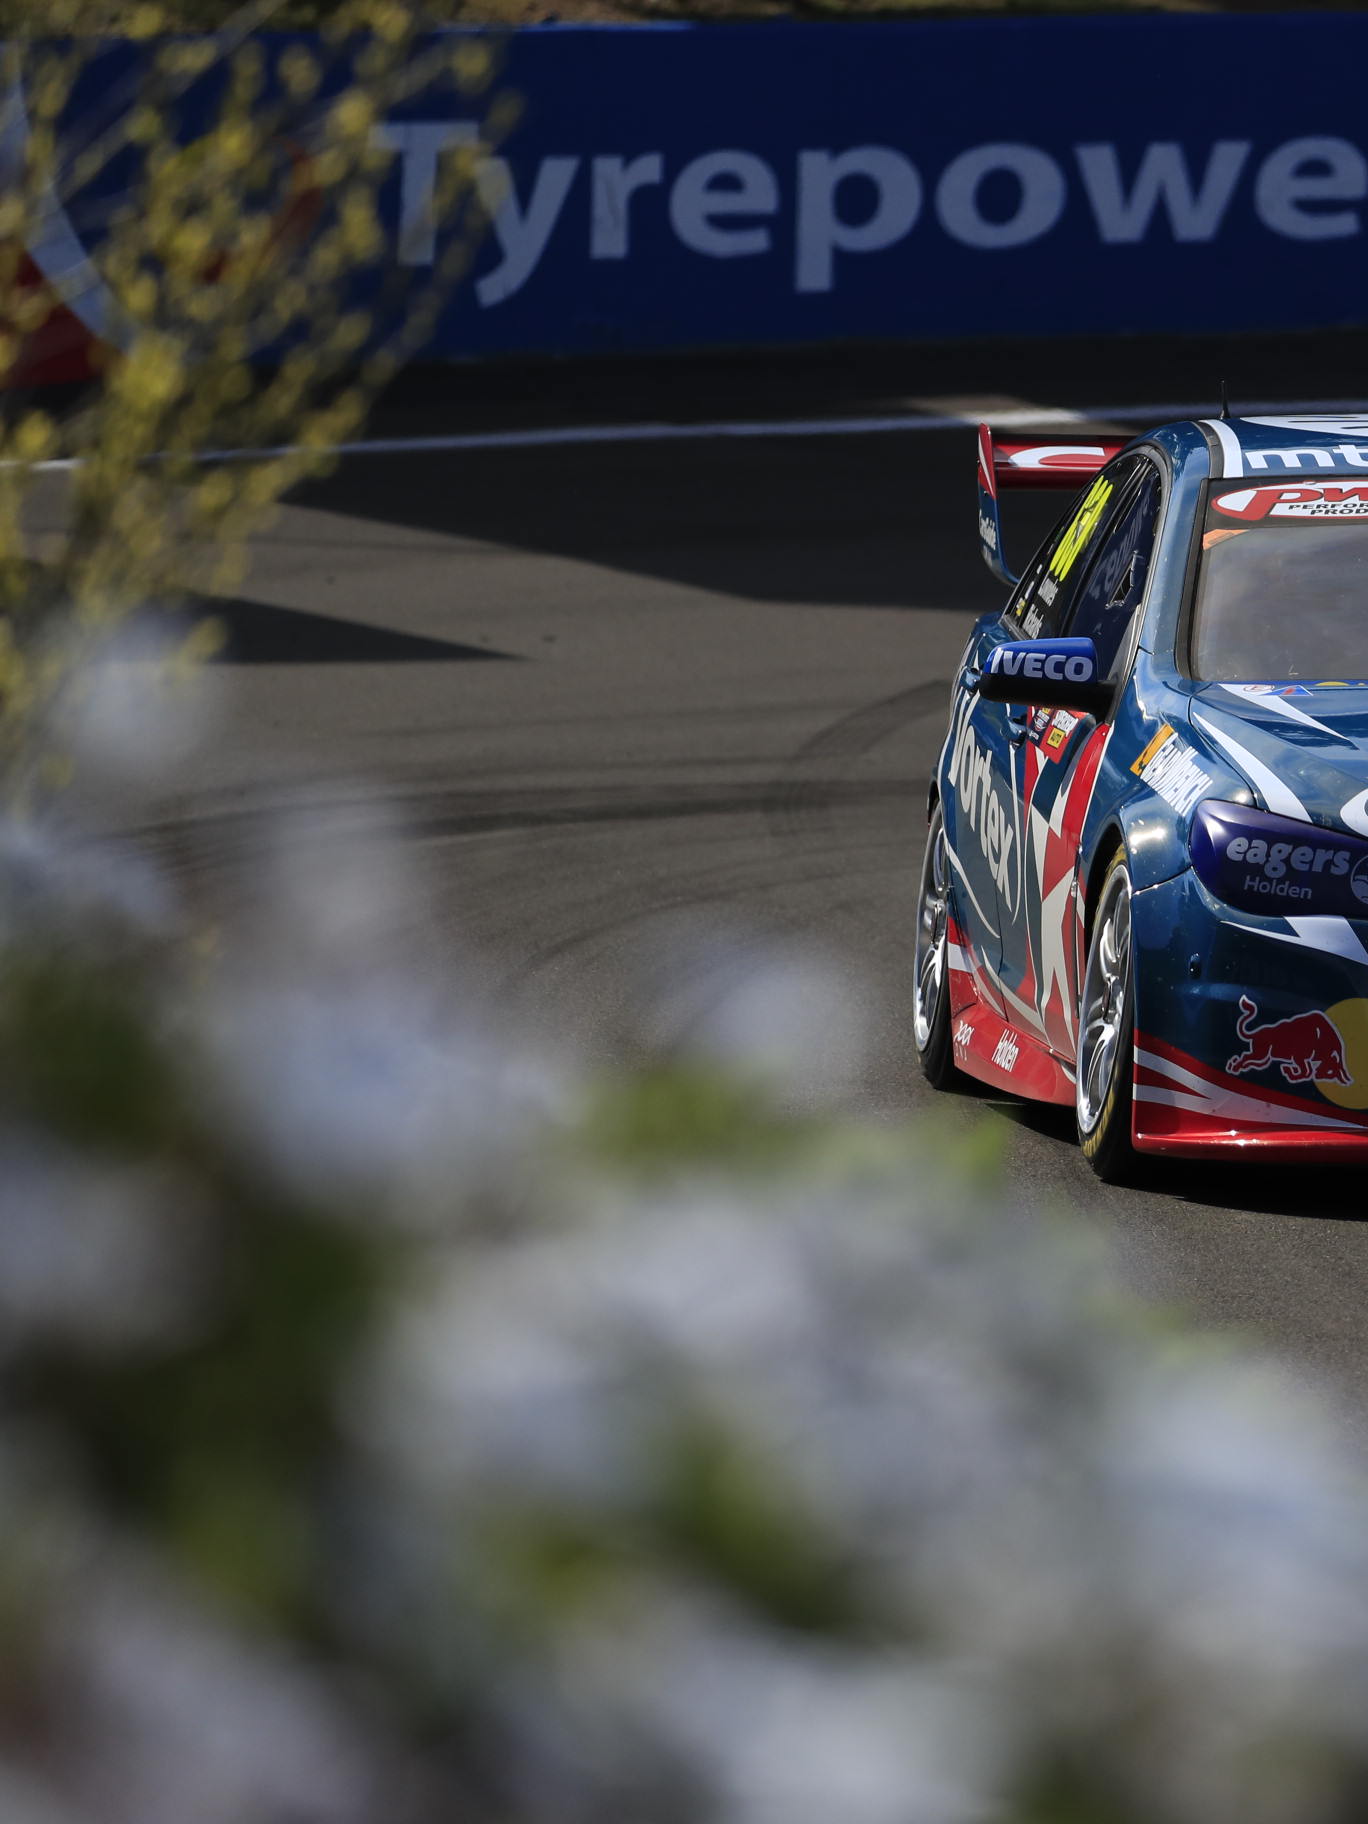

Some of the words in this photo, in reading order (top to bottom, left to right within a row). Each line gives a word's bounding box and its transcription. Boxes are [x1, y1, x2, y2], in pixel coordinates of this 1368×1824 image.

[990, 646, 1094, 682] IVECO
[947, 685, 1015, 913] Vortex
[1226, 836, 1351, 879] eagers
[1243, 874, 1313, 900] Holden
